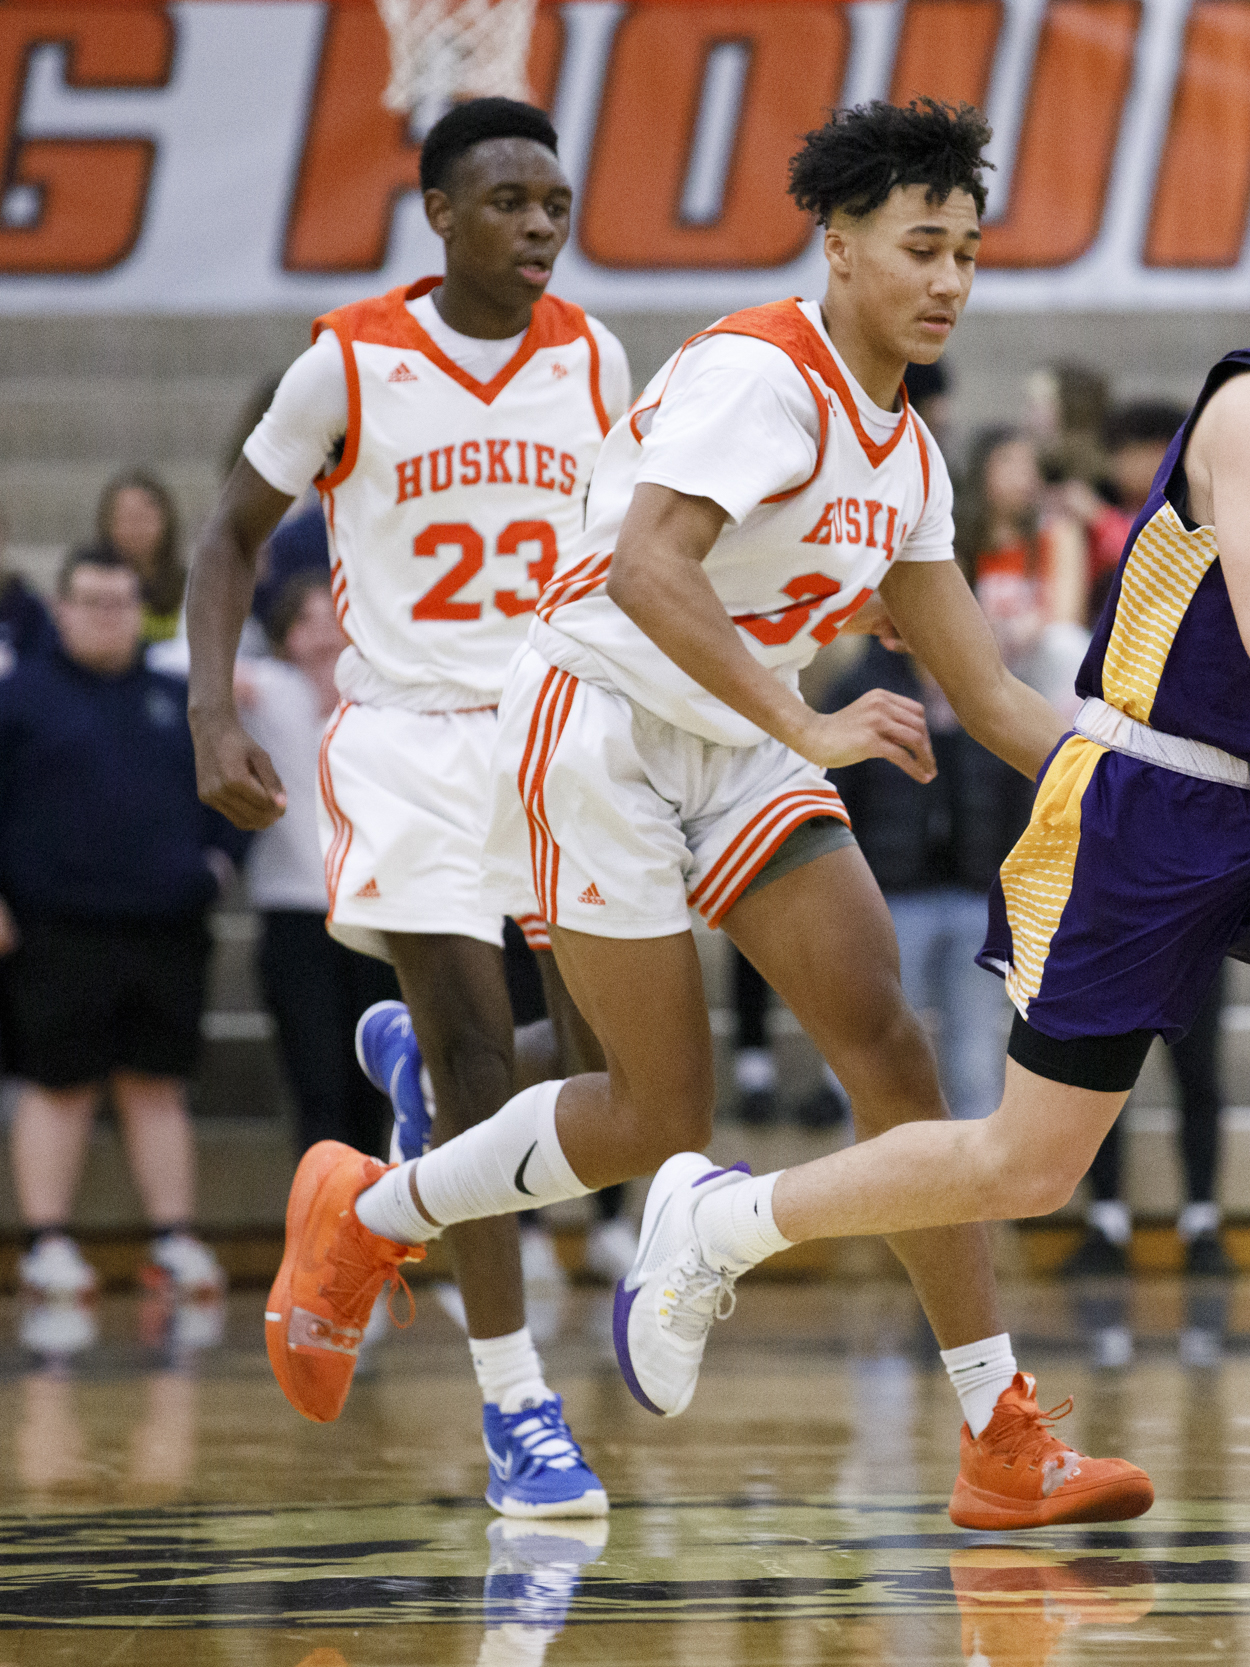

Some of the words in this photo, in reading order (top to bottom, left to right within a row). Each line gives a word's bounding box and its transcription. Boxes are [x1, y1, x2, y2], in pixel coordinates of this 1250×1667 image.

[395, 438, 578, 505] HUSKIES
[800, 496, 908, 562] HUSKI
[411, 519, 559, 621] 23
